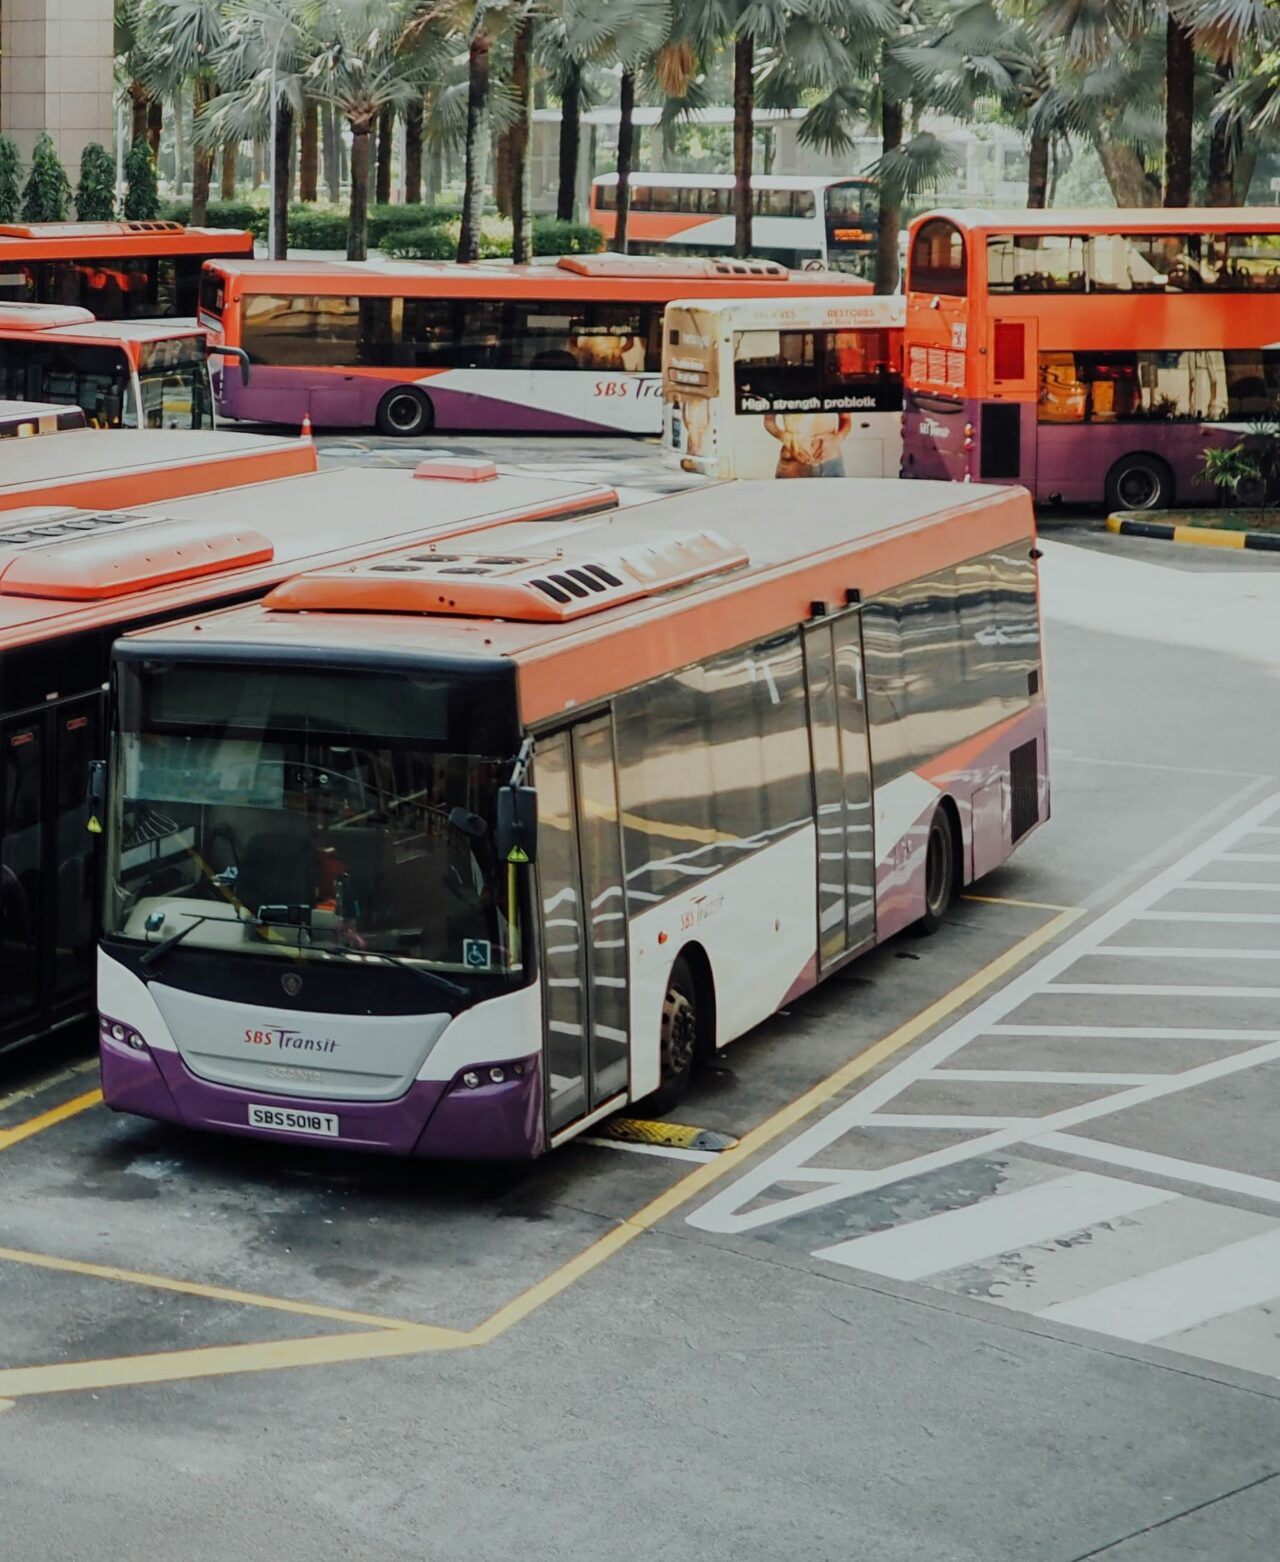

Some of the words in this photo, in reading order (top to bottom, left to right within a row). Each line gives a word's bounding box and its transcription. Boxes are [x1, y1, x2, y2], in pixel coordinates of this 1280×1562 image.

[593, 380, 628, 397] SBS
[742, 397, 770, 411] High
[773, 396, 820, 410] strength
[823, 395, 876, 410] probiotic
[244, 1029, 273, 1046] SBS
[272, 1029, 341, 1054] Transit
